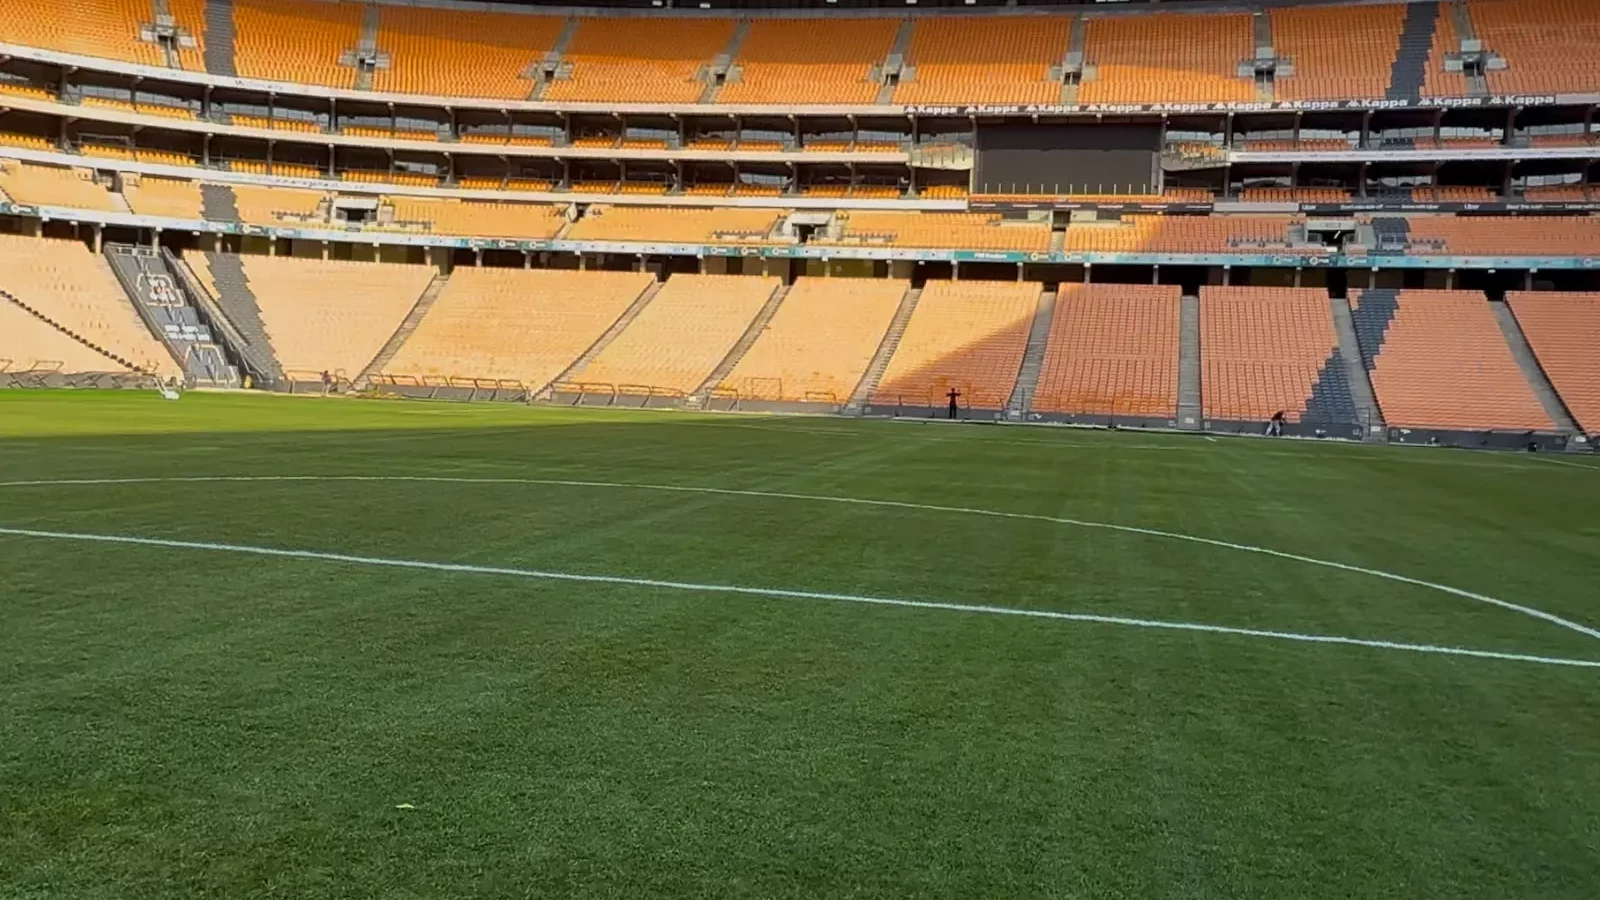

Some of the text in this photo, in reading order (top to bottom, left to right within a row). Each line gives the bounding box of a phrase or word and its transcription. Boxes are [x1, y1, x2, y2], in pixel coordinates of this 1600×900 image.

[1293, 100, 1338, 110] Kappa
[1361, 98, 1408, 109] Kappa
[1433, 97, 1481, 108] Kappa
[1505, 95, 1554, 106] Kappa
[918, 106, 957, 115] Kappa
[978, 105, 1018, 114] Kappa
[1038, 104, 1080, 114] Kappa
[1100, 104, 1142, 114] Kappa
[1164, 102, 1208, 113] Kappa
[1228, 102, 1272, 112] Kappa
